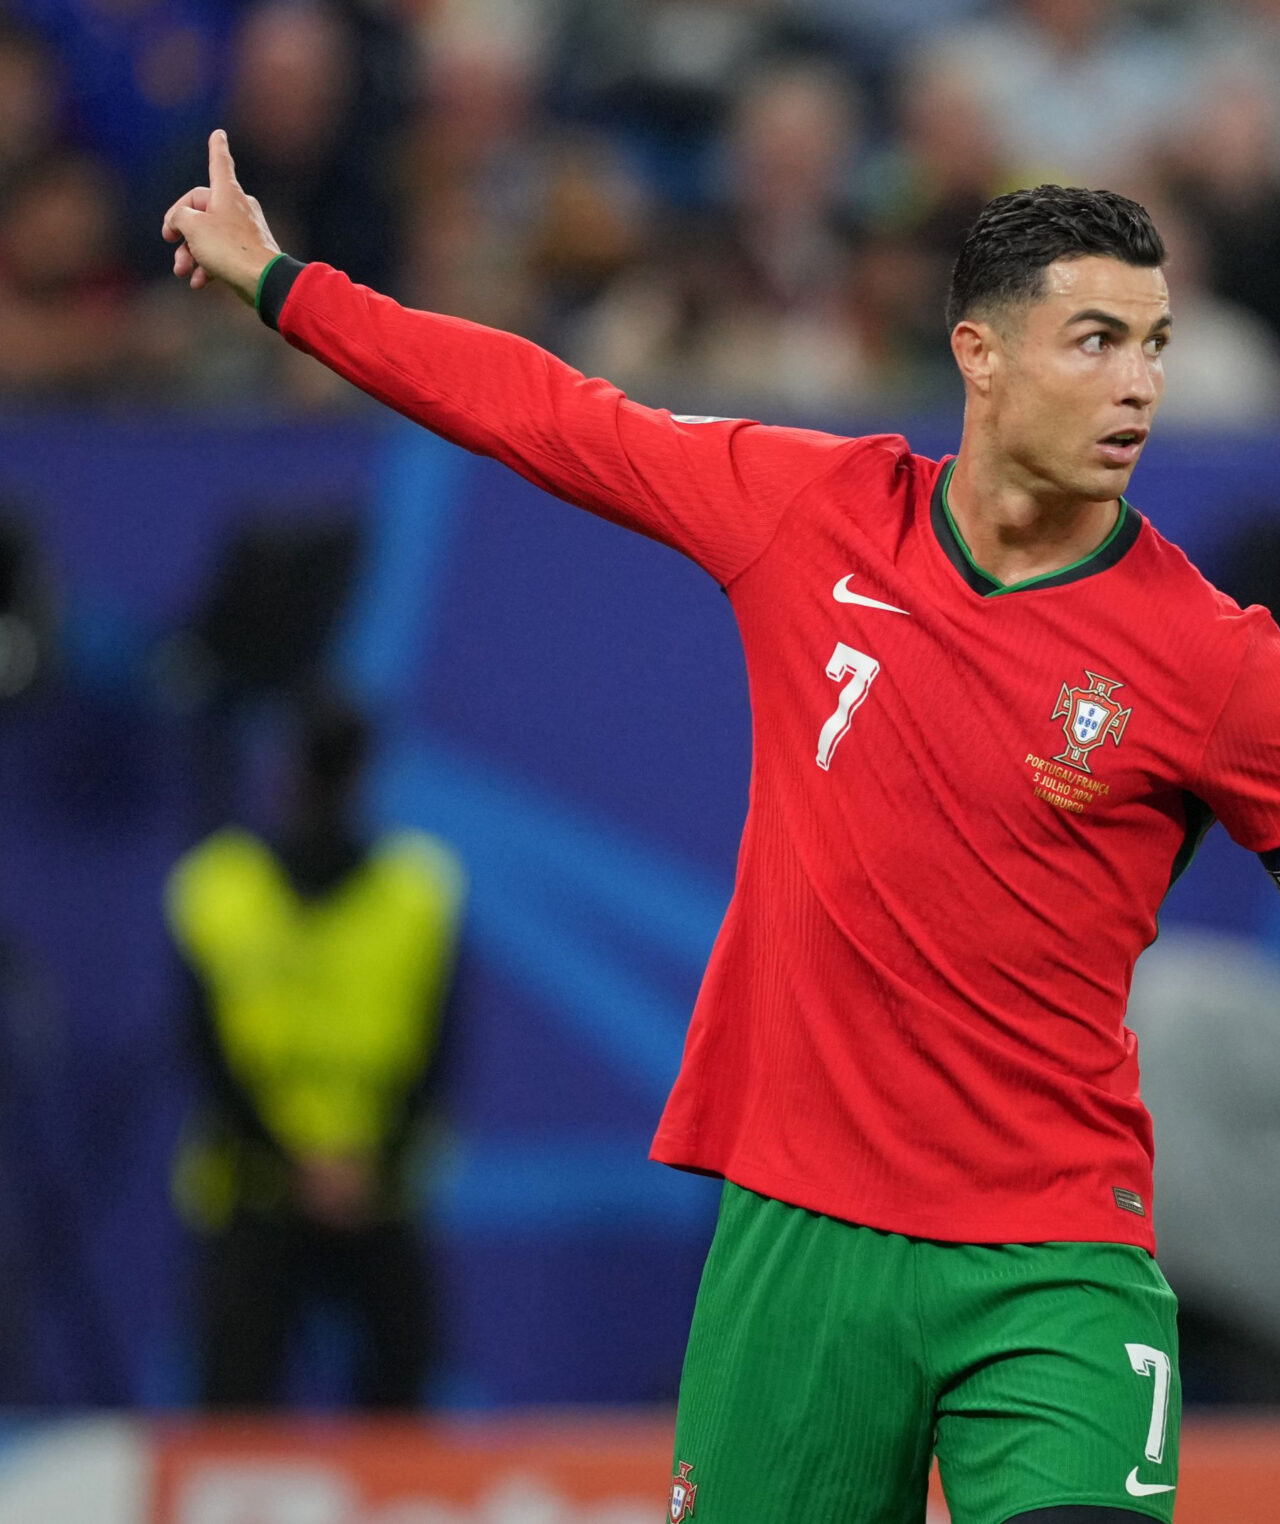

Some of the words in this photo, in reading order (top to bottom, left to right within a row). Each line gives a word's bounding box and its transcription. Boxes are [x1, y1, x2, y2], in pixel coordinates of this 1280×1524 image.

[815, 641, 880, 772] 7
[1025, 753, 1110, 796] PORTUGAL/FRANÇA
[1033, 772, 1041, 782] 5
[1041, 775, 1071, 796] JULHO
[1071, 788, 1093, 803] 2024
[1033, 786, 1084, 814] HAMBURGO
[1124, 1343, 1171, 1465] 7
